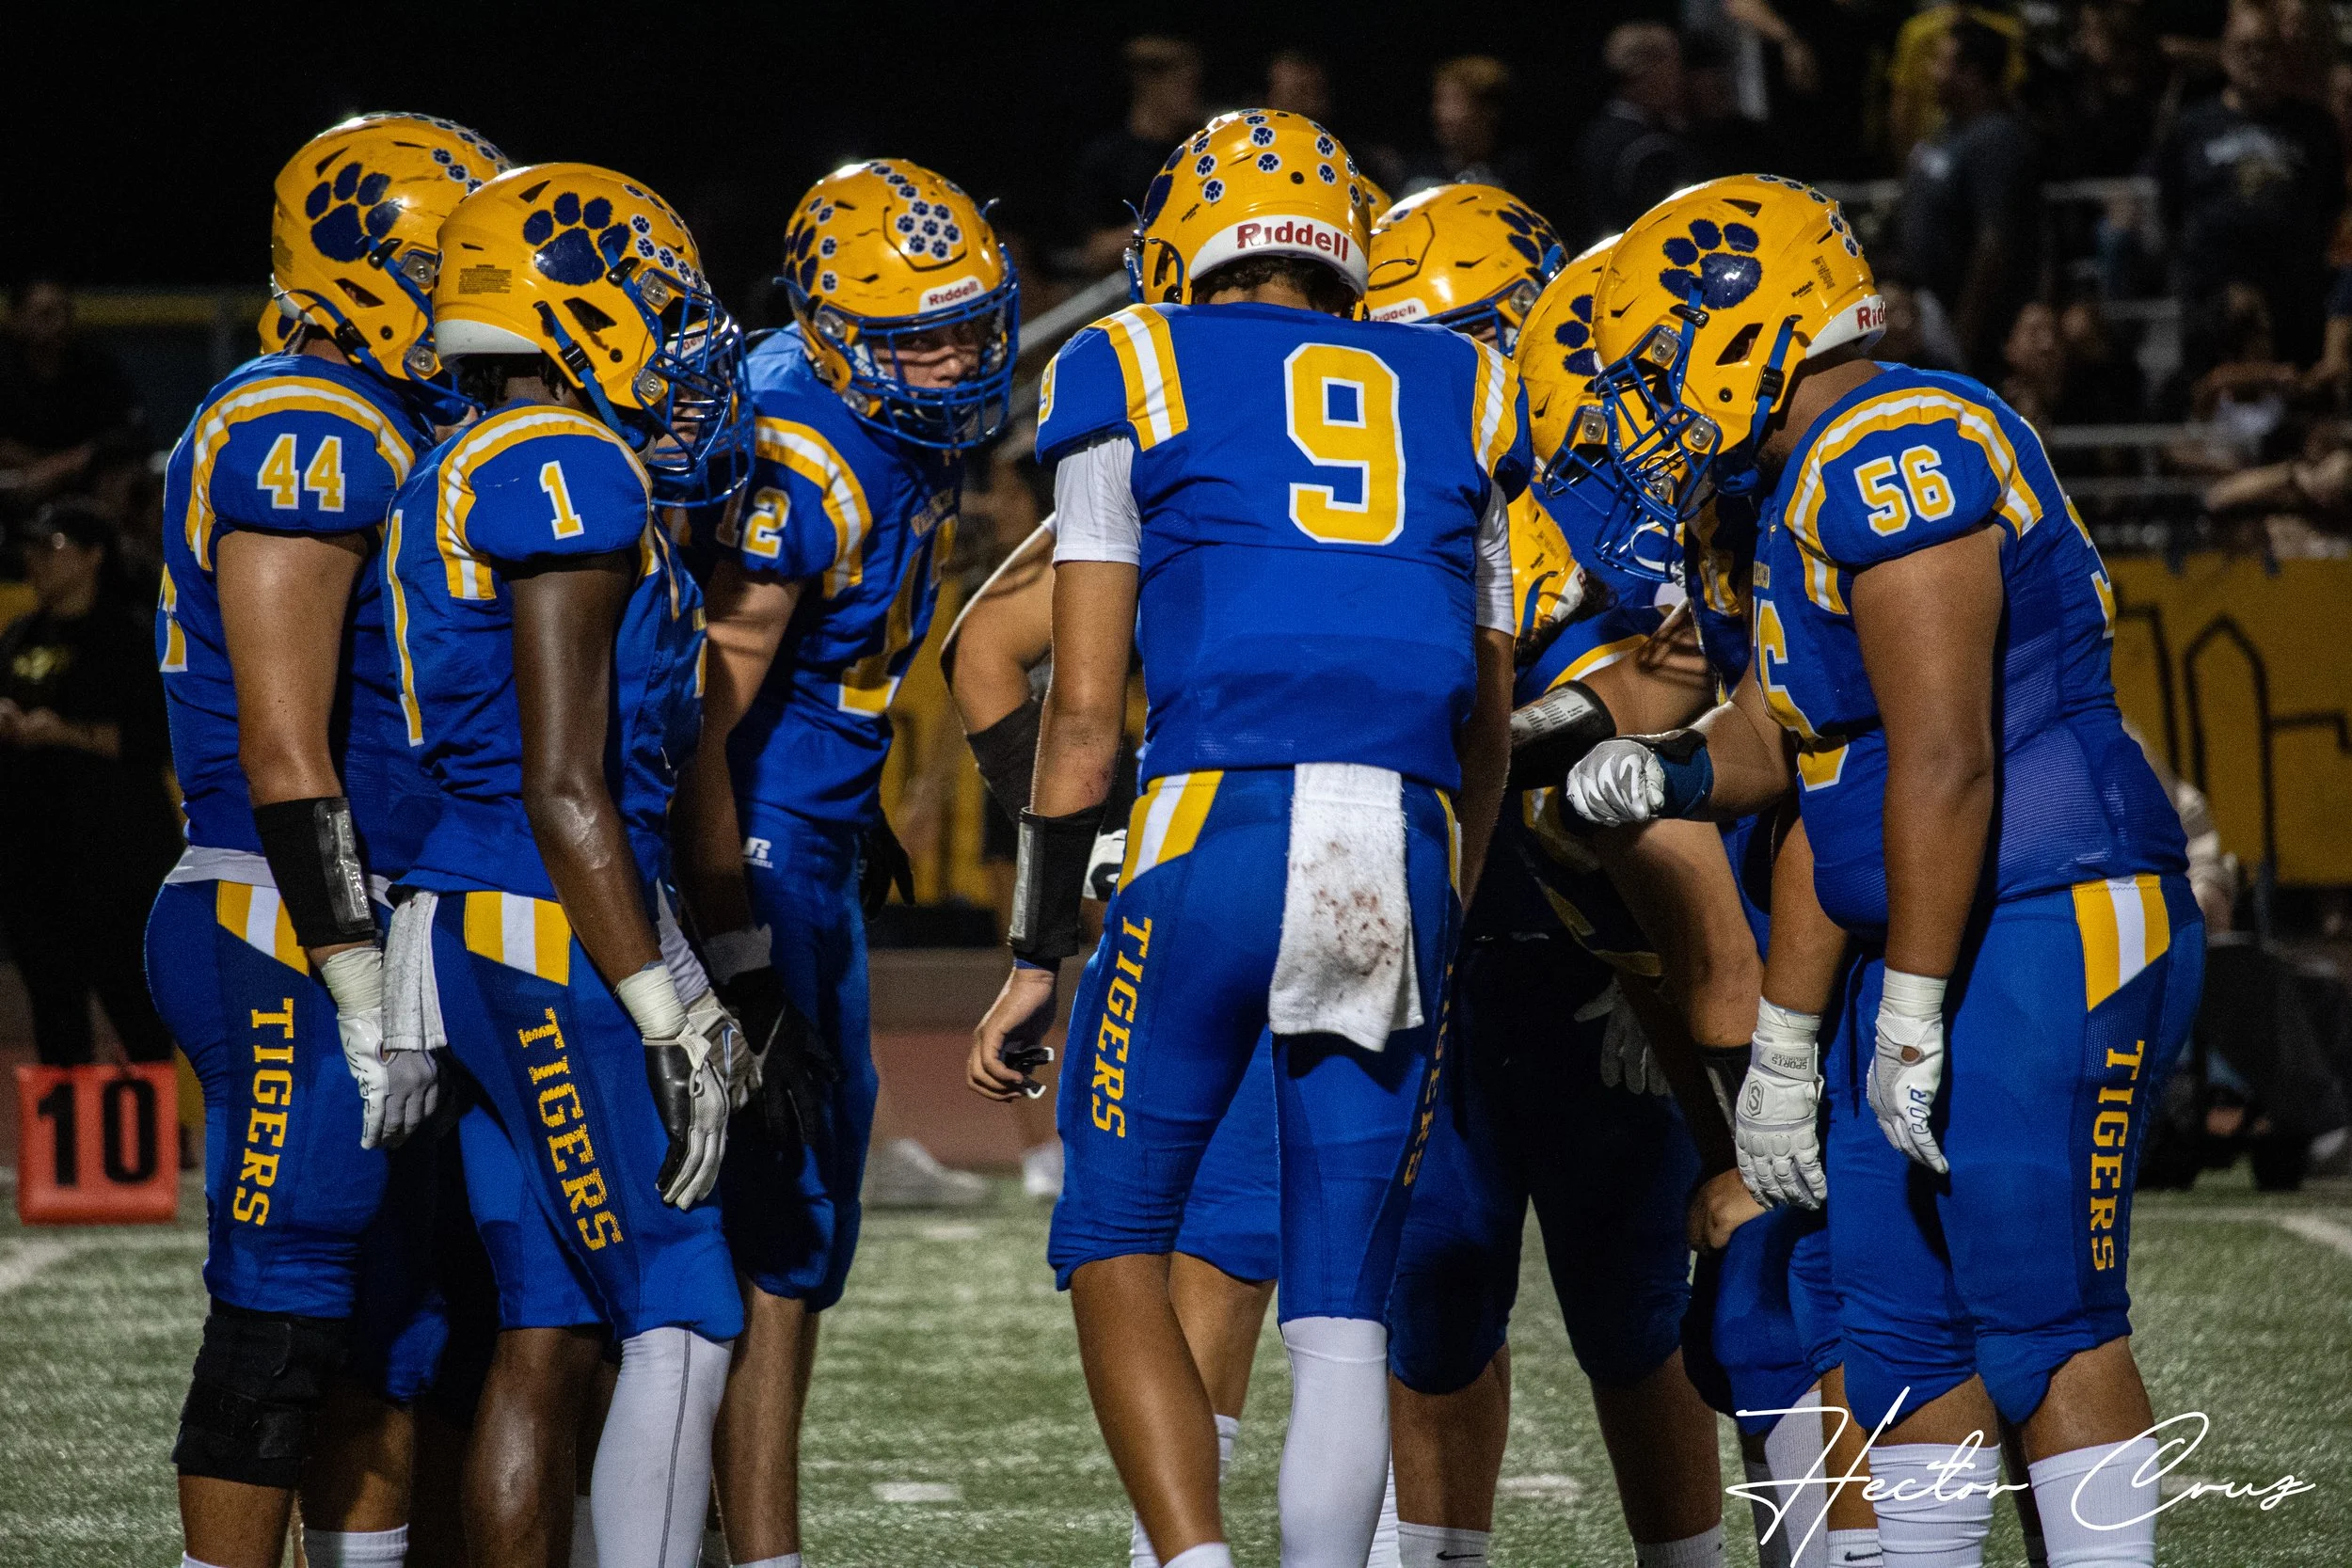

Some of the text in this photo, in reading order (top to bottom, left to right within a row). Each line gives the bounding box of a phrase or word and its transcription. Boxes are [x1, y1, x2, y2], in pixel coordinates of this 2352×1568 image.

[1236, 221, 1349, 261] Riddell
[929, 281, 978, 306] Riddell
[257, 434, 345, 513] 44
[1284, 341, 1406, 546] 9
[1853, 444, 1955, 536] 56
[539, 460, 584, 540] 1
[1091, 915, 1153, 1137] TIGERS
[1772, 1056, 1808, 1069] SPORTS
[36, 1078, 160, 1187] 10
[232, 997, 294, 1227] TIGERS
[518, 1007, 623, 1251] TIGERS
[2090, 1039, 2146, 1272] TIGERS
